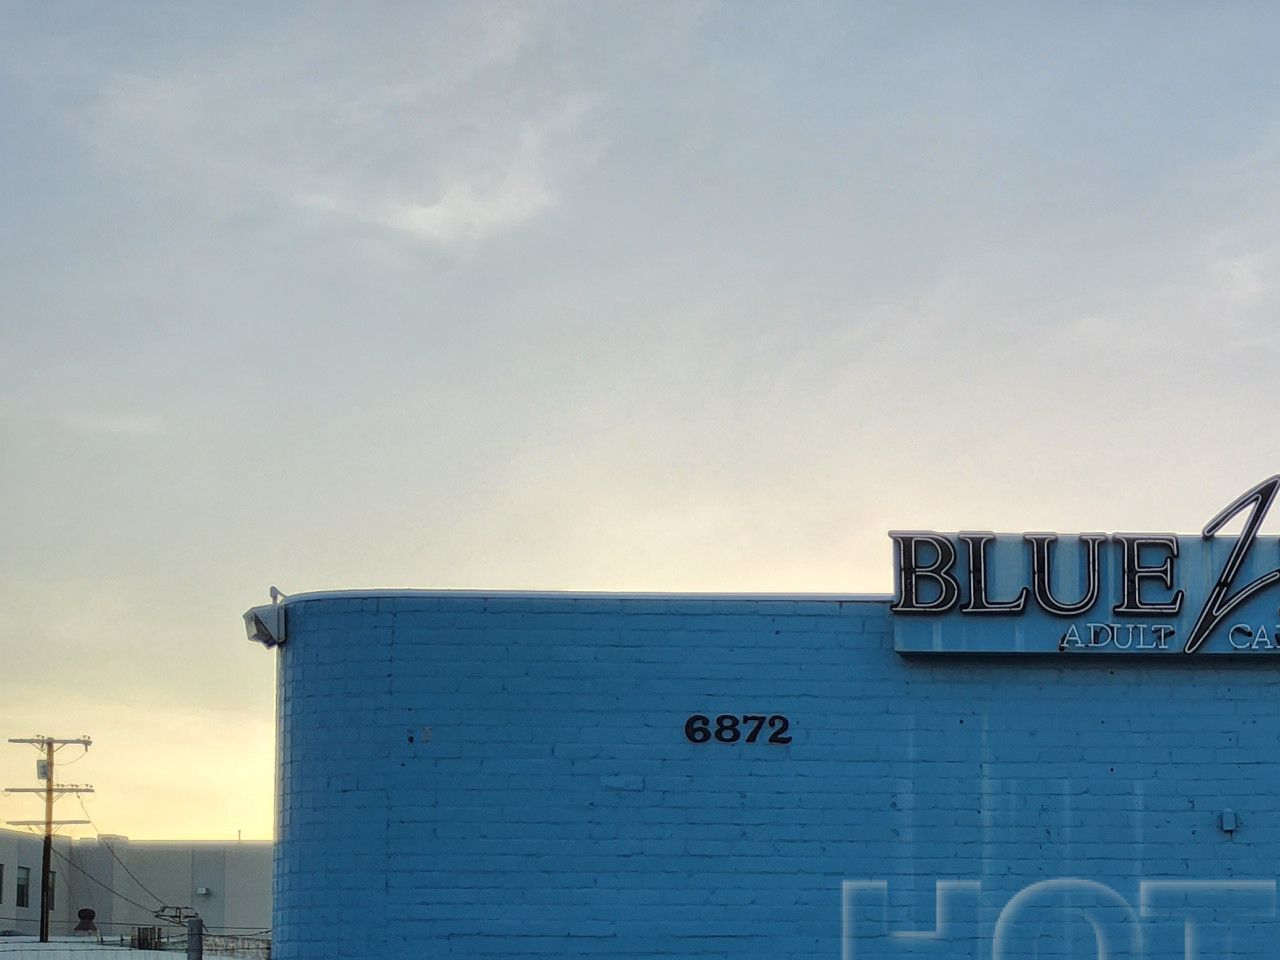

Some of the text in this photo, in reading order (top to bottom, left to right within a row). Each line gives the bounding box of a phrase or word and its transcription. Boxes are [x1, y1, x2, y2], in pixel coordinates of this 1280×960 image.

[888, 531, 1184, 616] BLUE
[1060, 623, 1174, 650] ADULT
[684, 714, 793, 744] 6872
